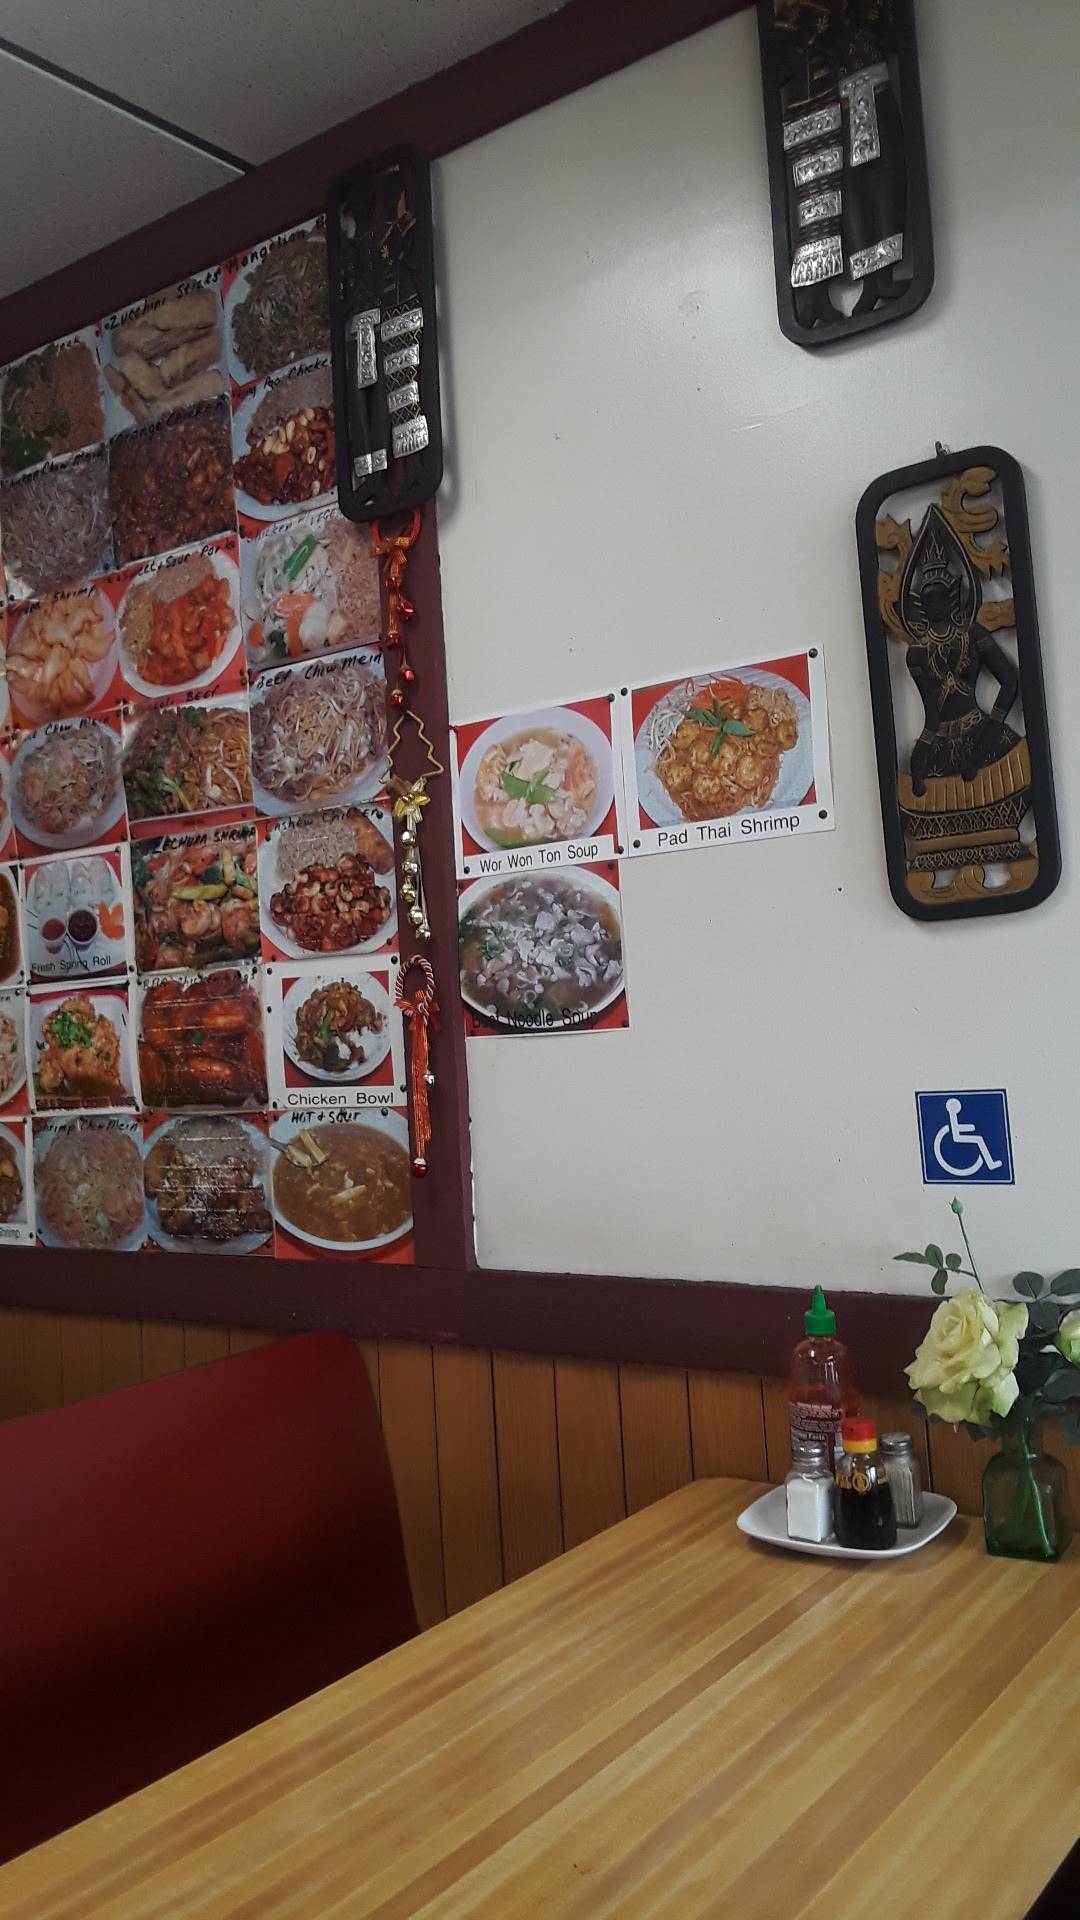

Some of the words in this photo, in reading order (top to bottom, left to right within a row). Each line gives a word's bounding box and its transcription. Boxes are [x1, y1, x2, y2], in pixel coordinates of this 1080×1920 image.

[658, 828, 688, 847] Pad
[696, 822, 732, 841] Thai
[741, 815, 800, 836] Shrimp
[480, 859, 502, 873] Wor
[507, 853, 533, 869] Won
[538, 848, 561, 864] Ton
[567, 844, 599, 860] Soup
[31, 961, 56, 973] Fresh
[60, 959, 88, 974] Spring
[92, 955, 111, 967] Roll
[507, 1005, 554, 1028] Noodle
[287, 1093, 347, 1106] Chicken
[356, 1091, 394, 1105] Bowl
